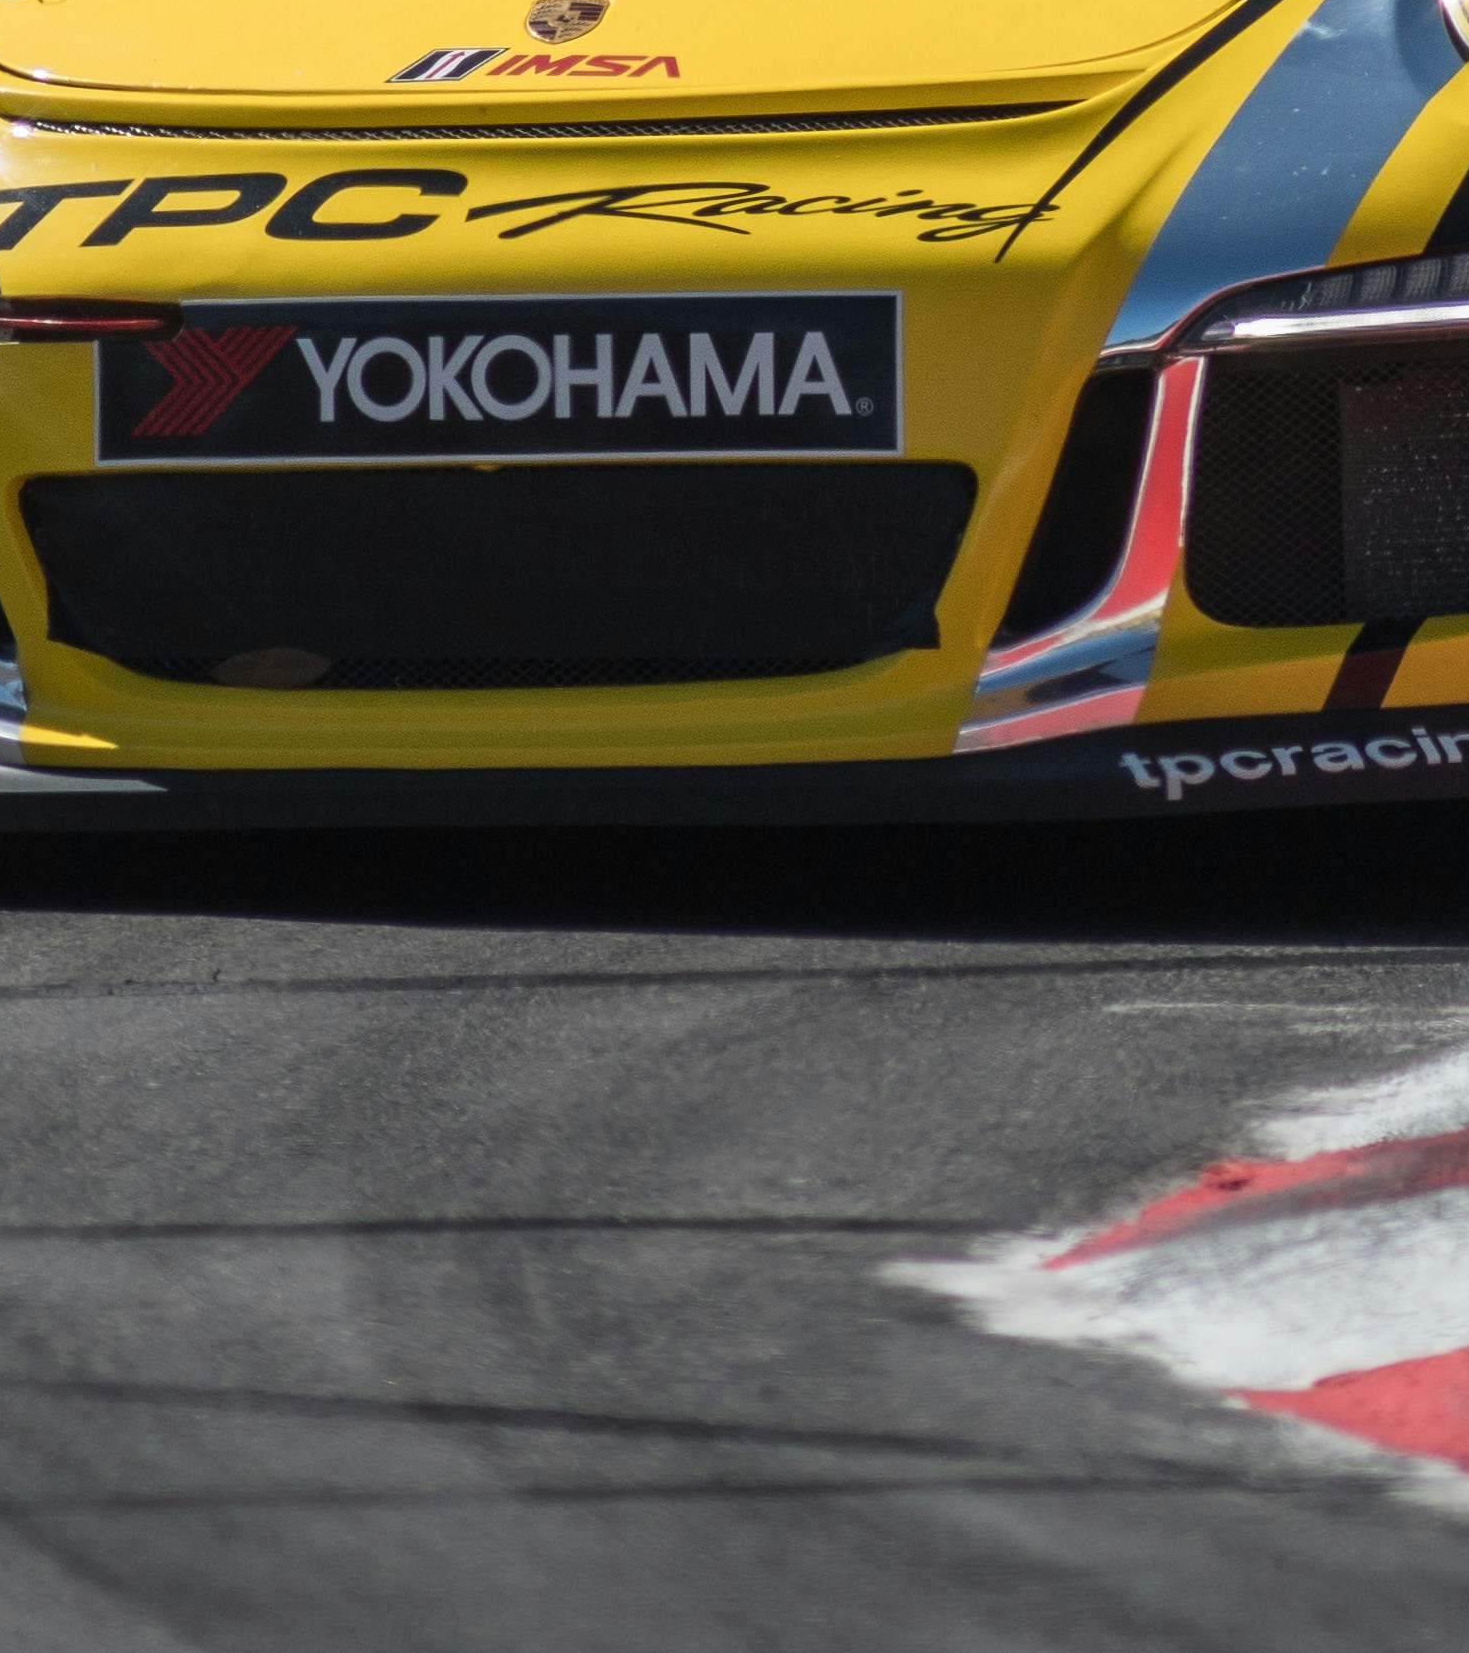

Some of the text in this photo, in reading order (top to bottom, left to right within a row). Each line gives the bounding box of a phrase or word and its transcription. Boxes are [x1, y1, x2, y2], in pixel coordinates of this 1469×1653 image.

[491, 52, 682, 80] IMSA
[466, 181, 1061, 242] Racing
[297, 331, 853, 423] YOKOHAMA
